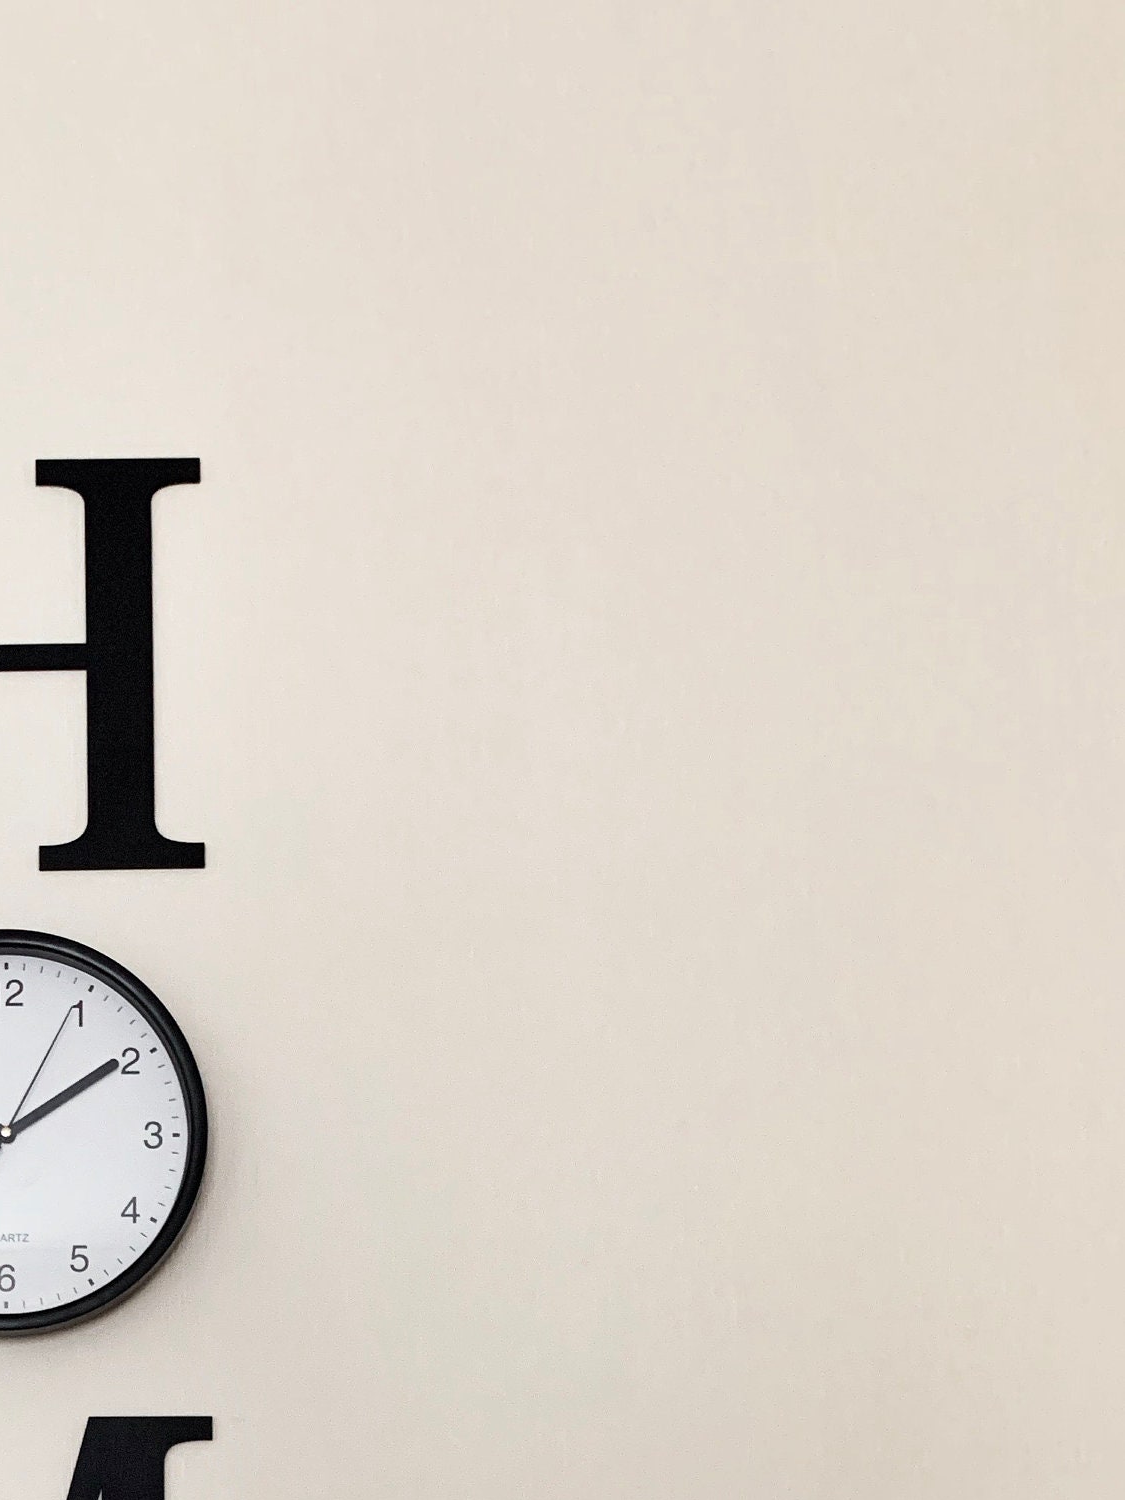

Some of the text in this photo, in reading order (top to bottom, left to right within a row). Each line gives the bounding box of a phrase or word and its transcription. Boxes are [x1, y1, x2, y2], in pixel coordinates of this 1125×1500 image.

[71, 1000, 84, 1028] 1
[120, 1047, 141, 1075] 2
[143, 1121, 163, 1150] 3
[120, 1196, 141, 1224] 4
[69, 1244, 90, 1273] 5
